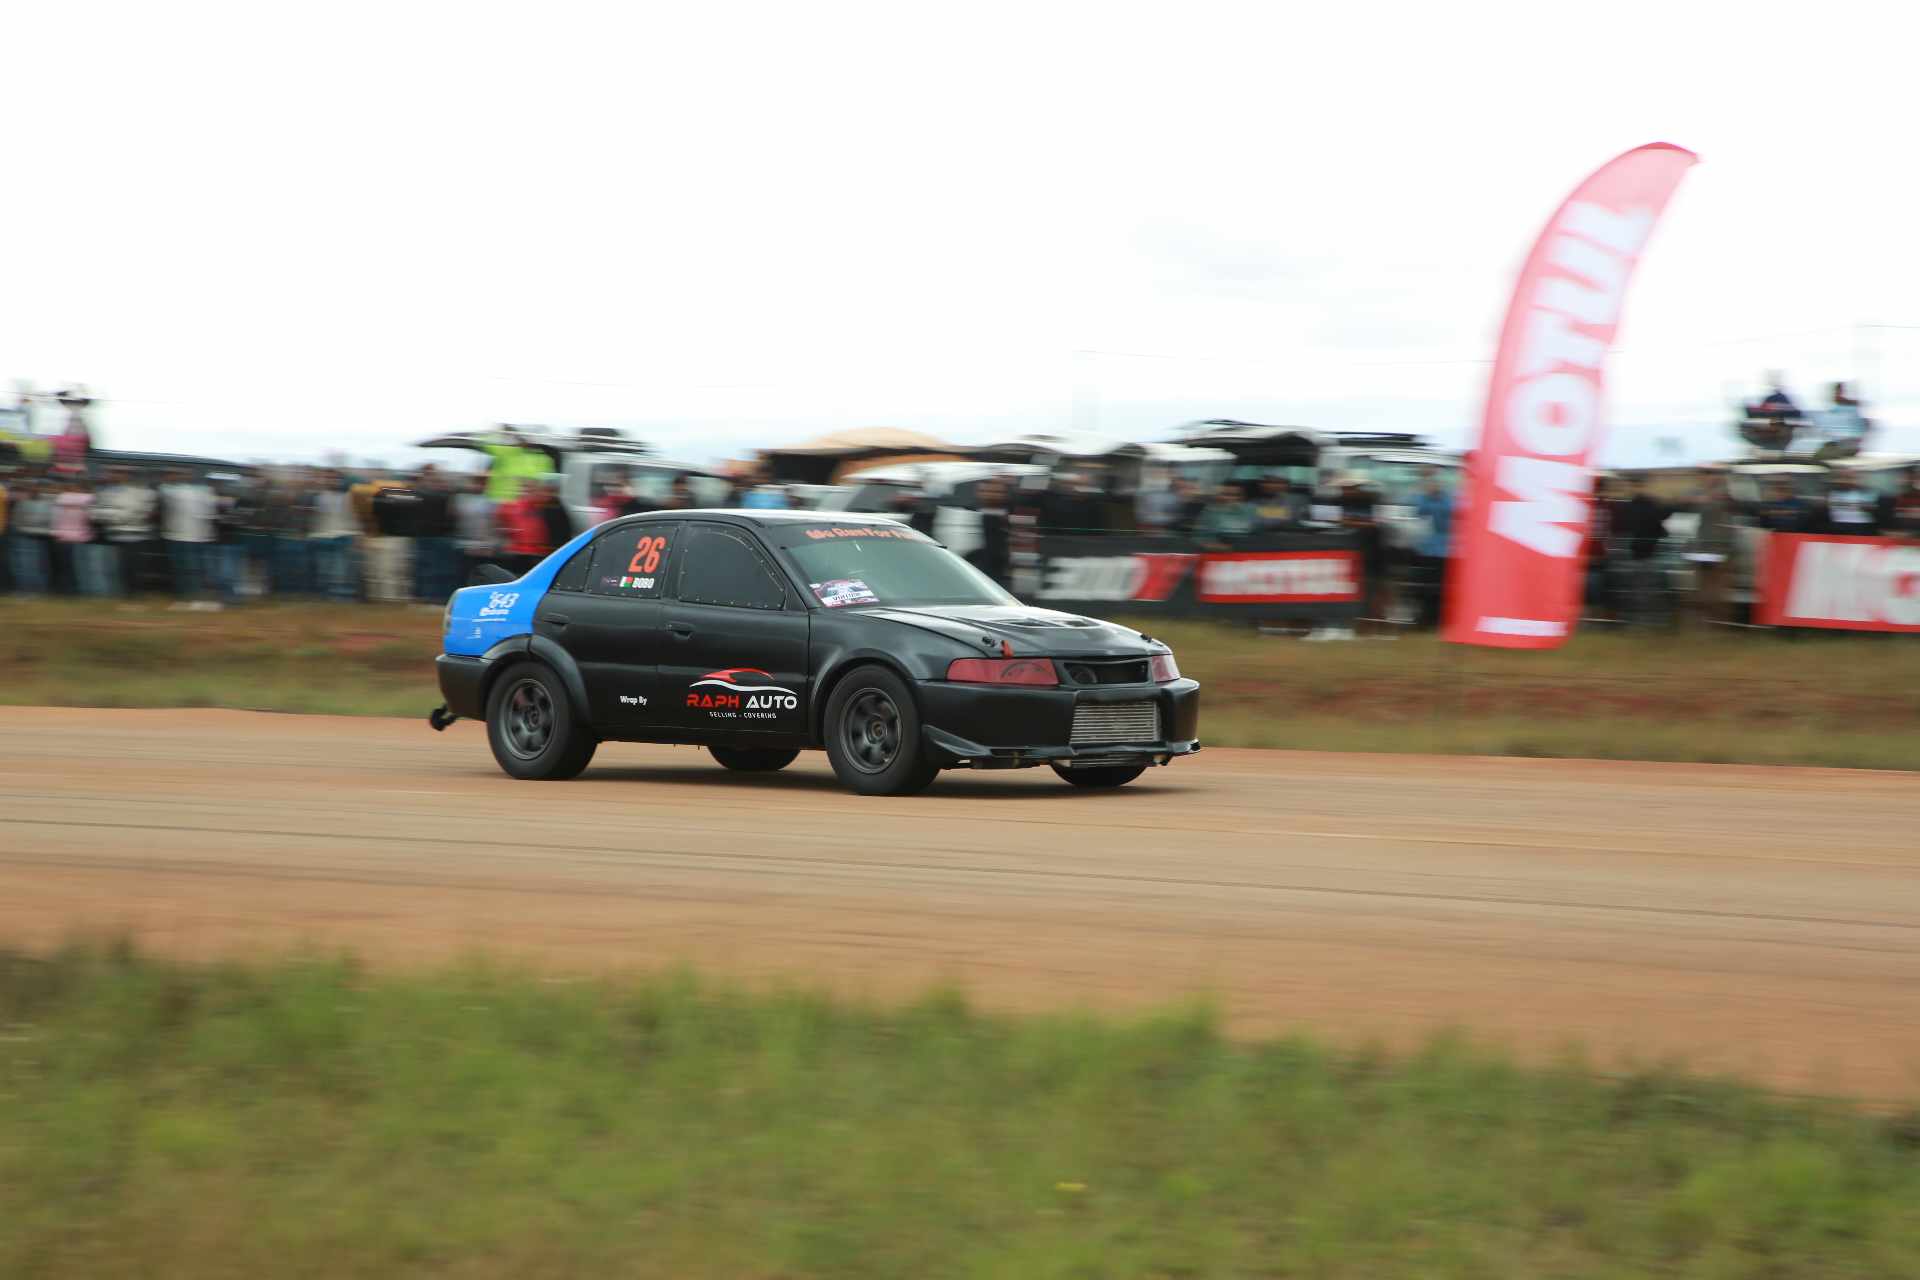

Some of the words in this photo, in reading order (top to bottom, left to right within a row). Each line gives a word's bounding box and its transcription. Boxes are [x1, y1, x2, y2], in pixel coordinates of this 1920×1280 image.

[1487, 200, 1656, 558] MOTUL
[628, 536, 666, 573] 26
[620, 695, 638, 706] Wrap
[639, 696, 648, 706] By
[687, 694, 740, 709] RAPH
[745, 695, 797, 710] AUTO
[709, 711, 737, 719] SELLING
